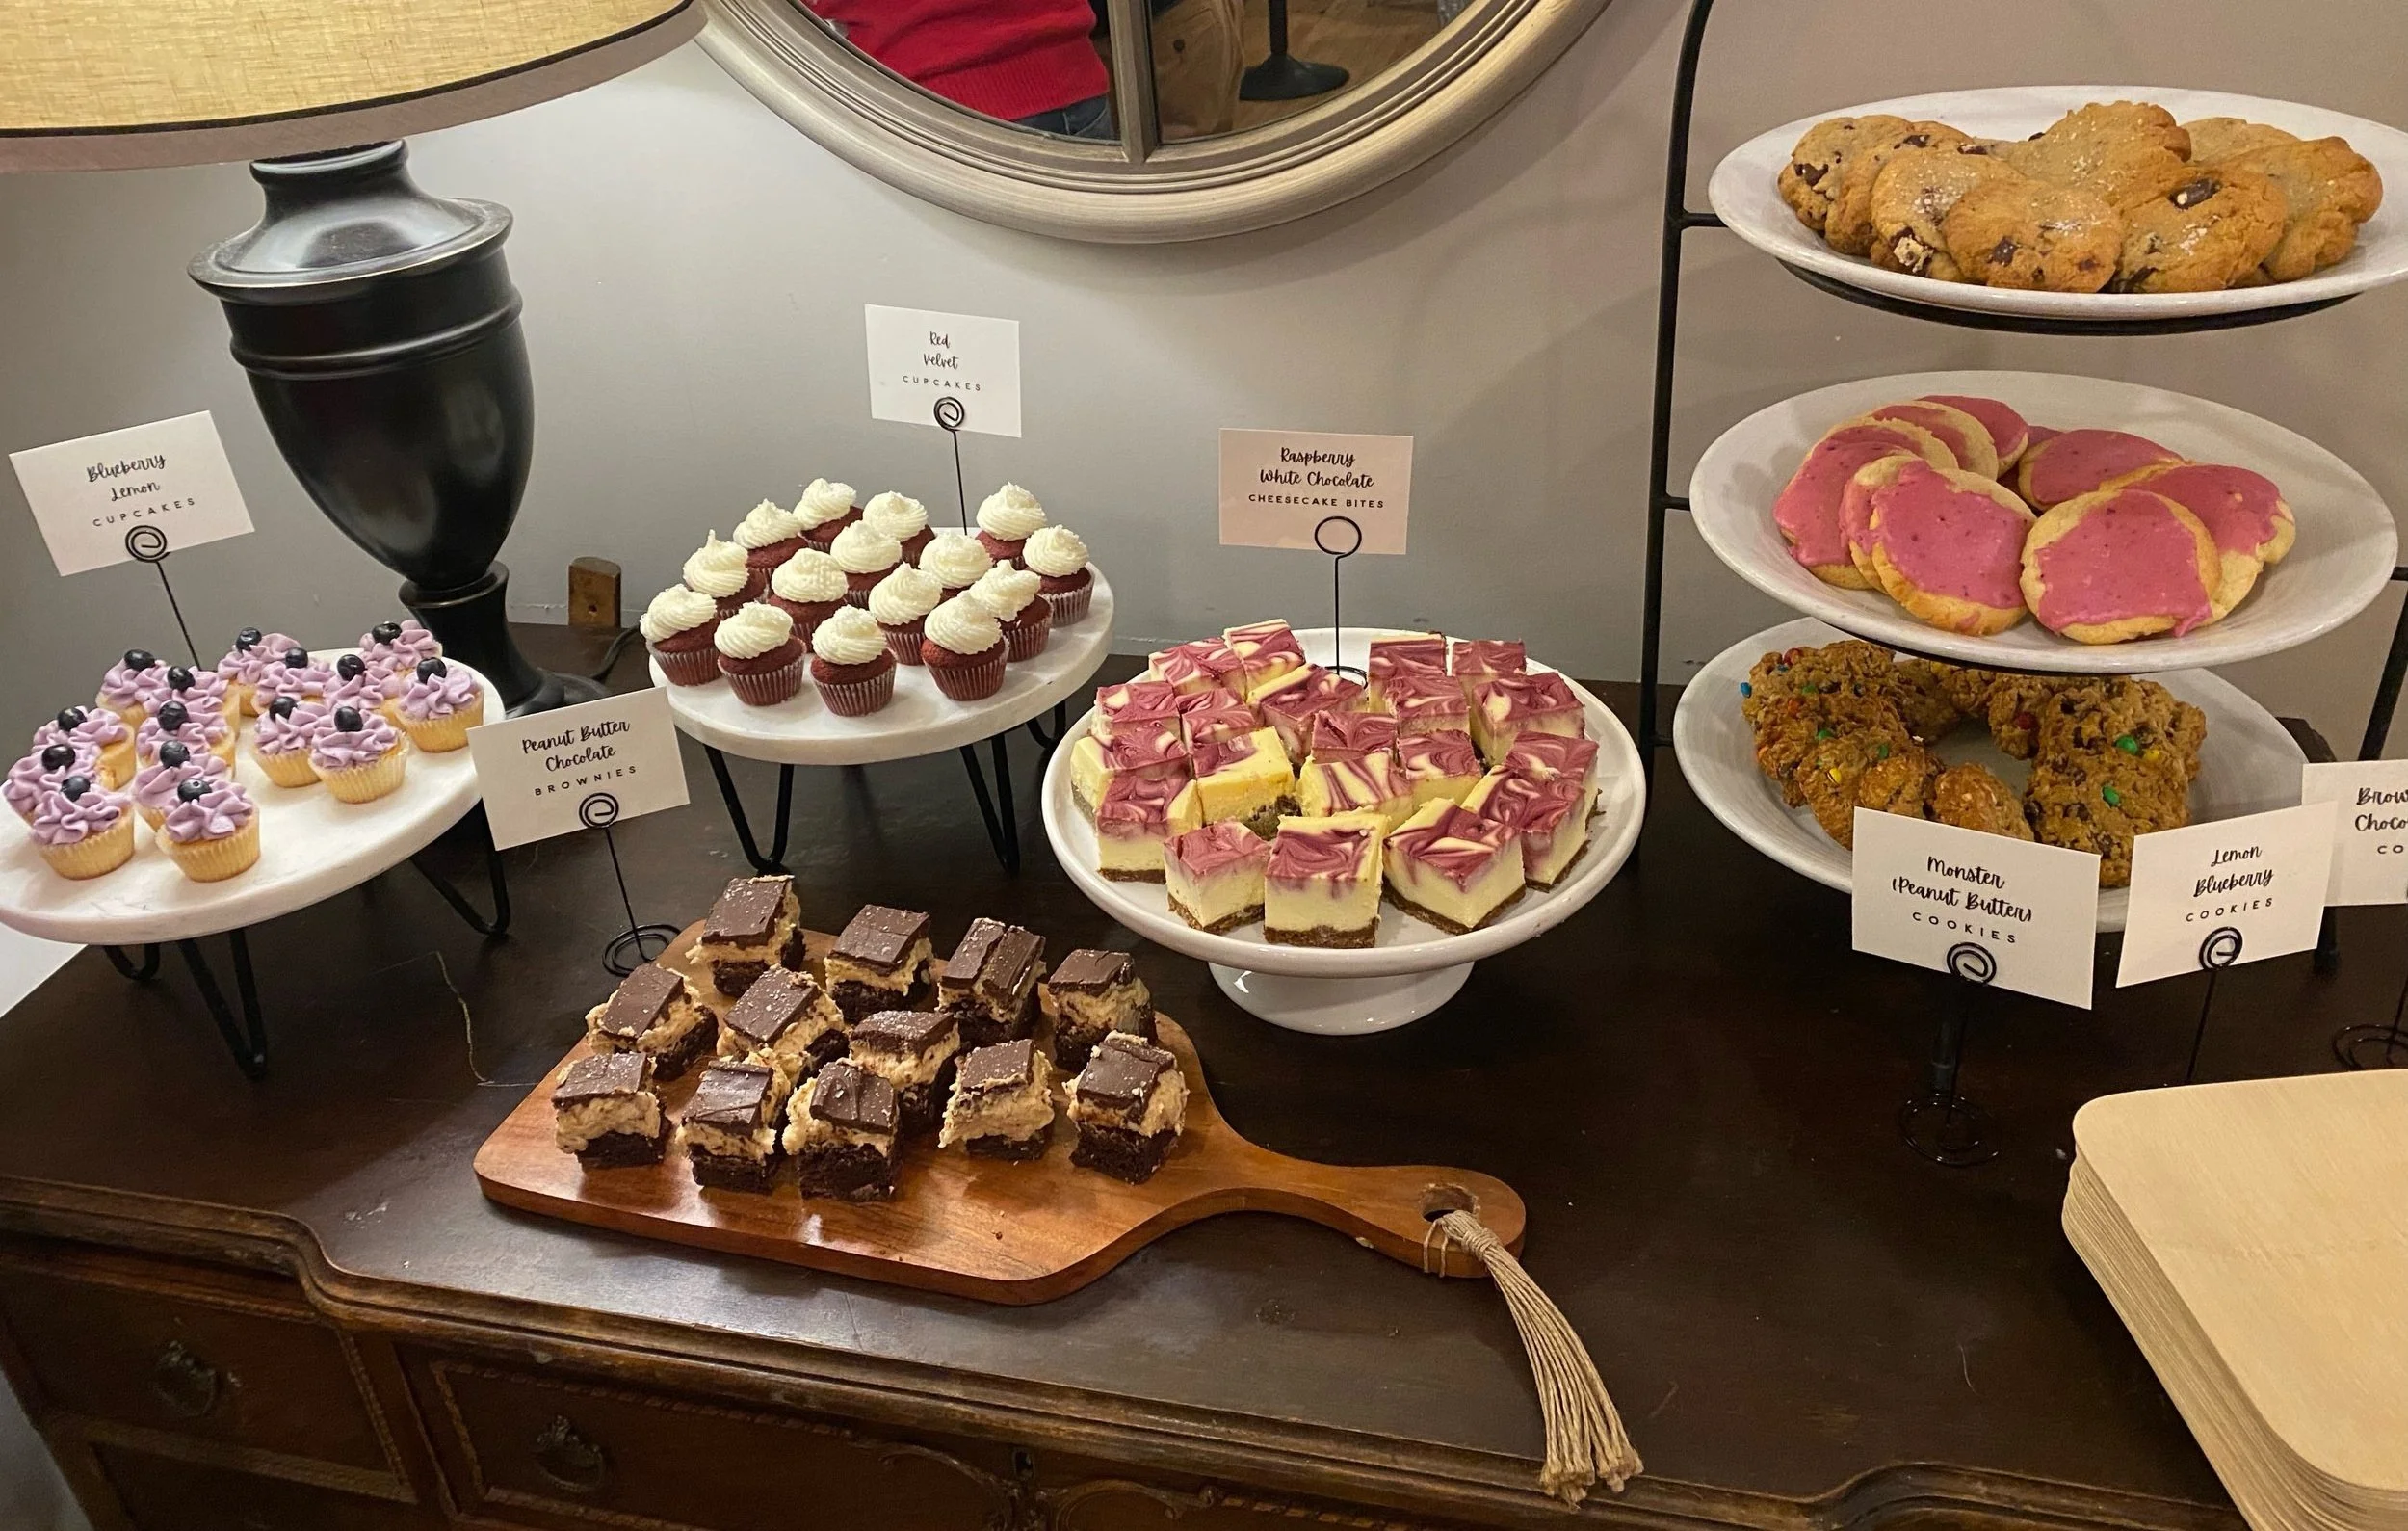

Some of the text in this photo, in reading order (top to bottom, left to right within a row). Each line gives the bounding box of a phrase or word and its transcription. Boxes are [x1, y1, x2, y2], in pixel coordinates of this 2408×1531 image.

[929, 330, 951, 349] Red
[923, 353, 958, 370] Velvet
[902, 375, 981, 391] CUPCAKES
[86, 454, 166, 483] Blueberry
[1280, 446, 1356, 468] Raspberry
[1260, 469, 1374, 488] White Chocolate
[111, 482, 160, 502] Lemon
[1248, 493, 1384, 509] CHEESECAKE BITES
[92, 497, 195, 527] CUPCAKES
[521, 721, 630, 754] Peanut Butter
[545, 746, 617, 772] Chocolate
[534, 765, 637, 796] BROWNIES
[2210, 846, 2263, 867] Lemon
[1926, 856, 2005, 889] Monster
[2192, 868, 2274, 898] Blueberry
[1892, 876, 2032, 922] (Peanut Butter)
[2186, 897, 2273, 922] COOKIES
[1912, 911, 2017, 944] COOKIES
